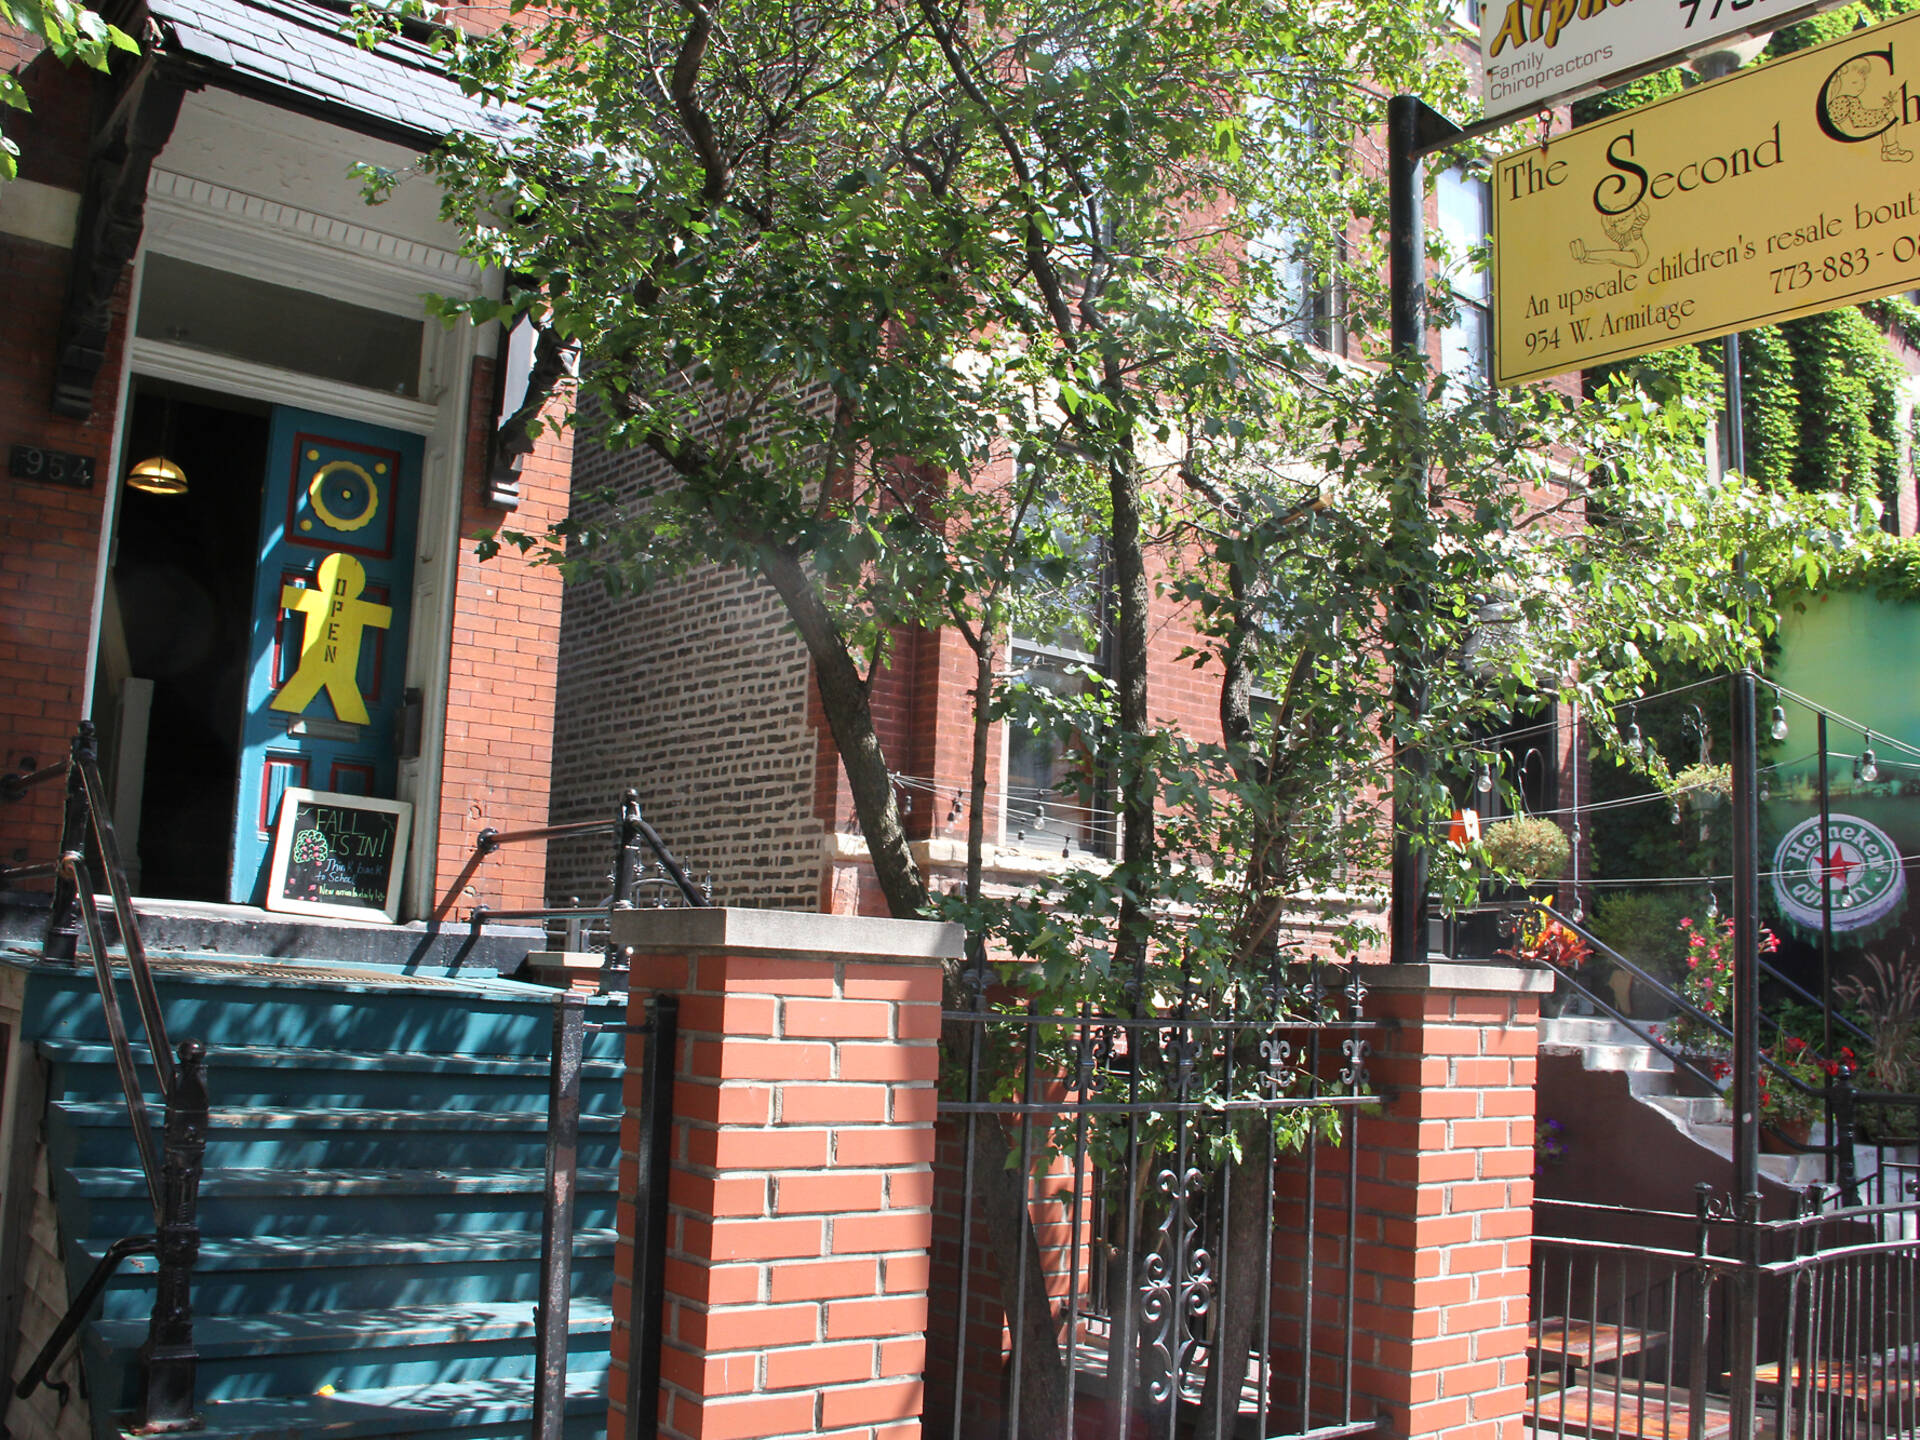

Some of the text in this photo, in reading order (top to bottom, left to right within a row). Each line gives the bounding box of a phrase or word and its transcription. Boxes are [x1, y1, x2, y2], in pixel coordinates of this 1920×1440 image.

[1489, 51, 1544, 84] Family
[1490, 45, 1614, 101] Chiropractors
[1504, 156, 1568, 201] The
[1593, 119, 1784, 216] Second
[1525, 190, 1920, 319] An upscale children's resale bout
[1525, 298, 1695, 356] 954 W. Armitage
[26, 449, 91, 485] 954
[324, 578, 347, 663] OPEN
[316, 808, 365, 835] FALL
[329, 834, 350, 856] IS
[1792, 883, 1874, 908] QULTY
